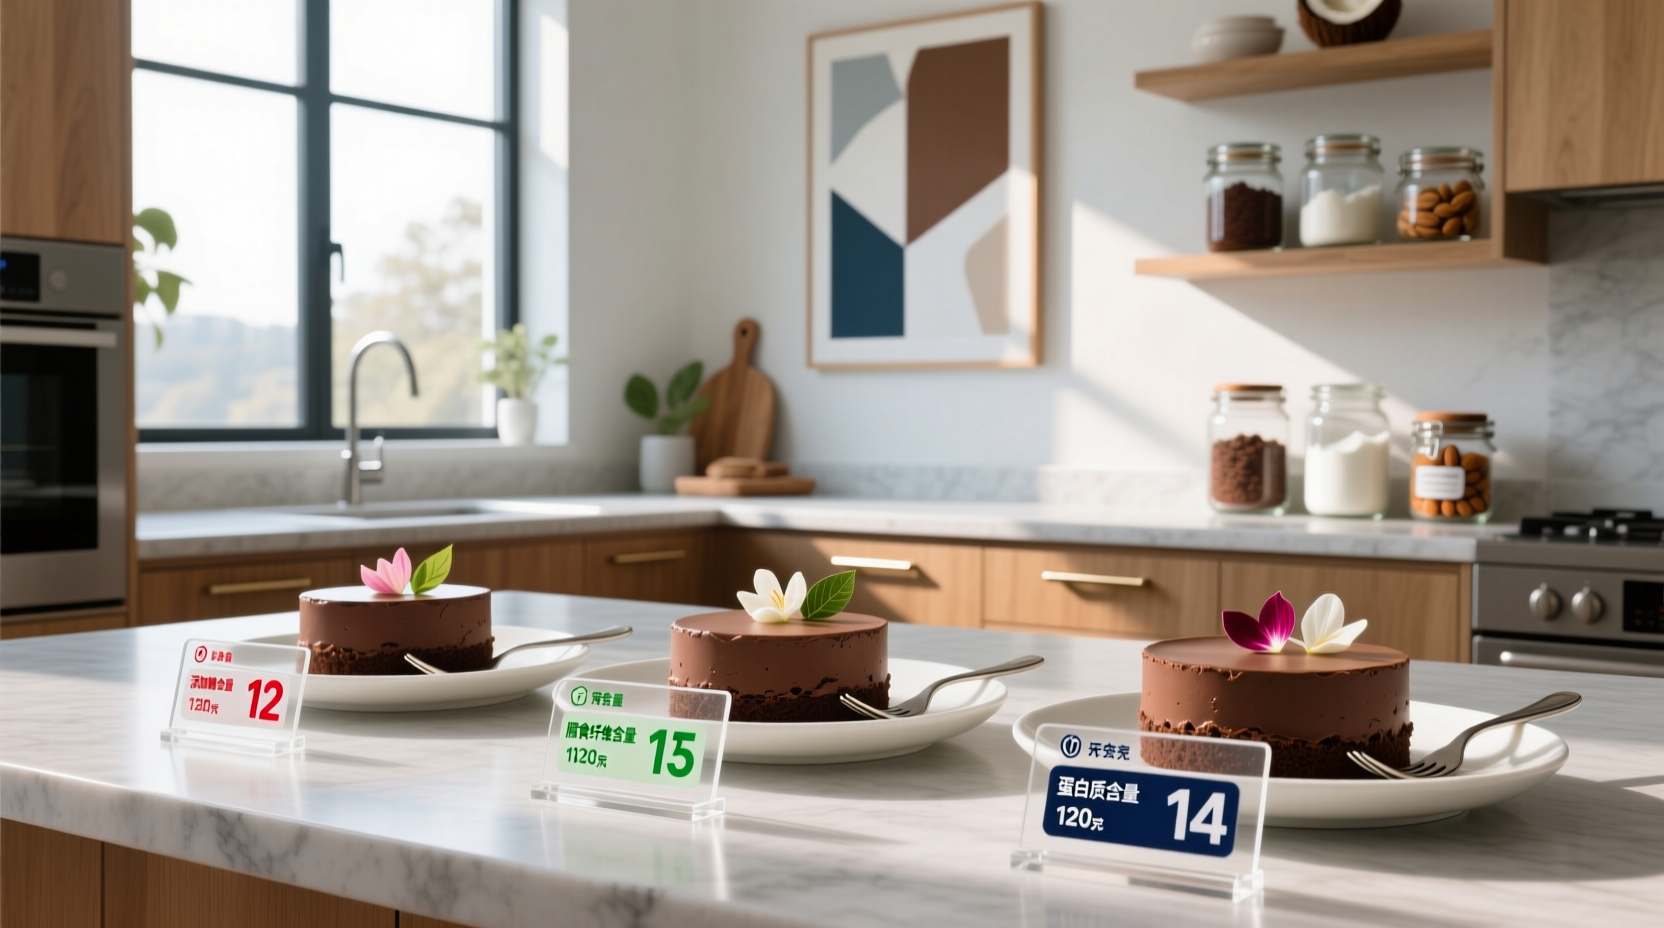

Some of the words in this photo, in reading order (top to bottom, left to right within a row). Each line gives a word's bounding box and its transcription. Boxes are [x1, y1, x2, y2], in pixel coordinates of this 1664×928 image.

[248, 679, 284, 722] 12
[649, 729, 697, 778] 15
[1056, 775, 1140, 804] 蛋白质含量
[1167, 788, 1228, 846] 14
